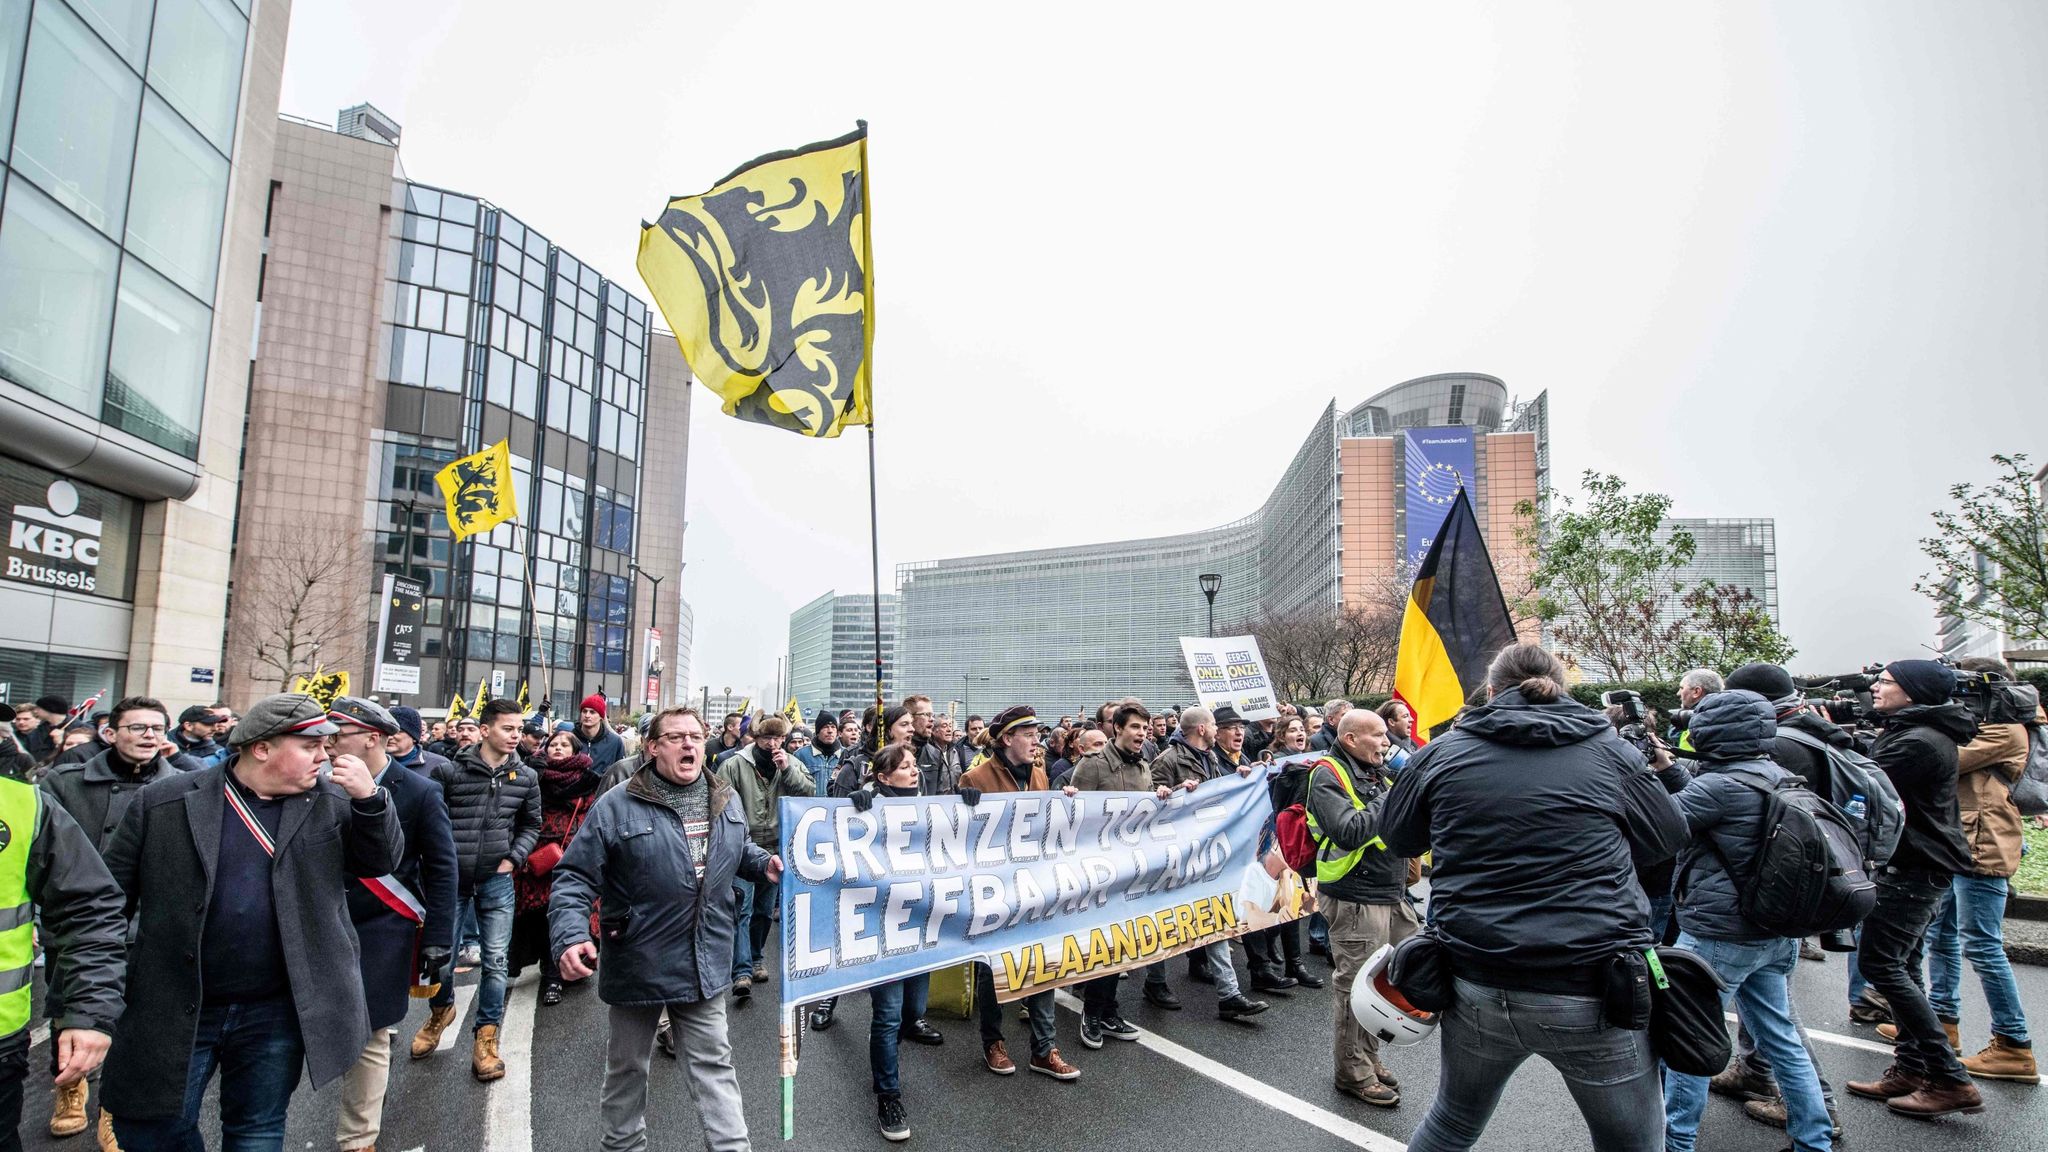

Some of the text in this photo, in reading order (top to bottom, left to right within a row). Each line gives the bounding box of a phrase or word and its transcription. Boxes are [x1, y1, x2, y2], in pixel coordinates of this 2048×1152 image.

[9, 520, 100, 566] KBC
[6, 556, 96, 591] Brussels
[395, 624, 413, 635] CATS
[1195, 654, 1215, 664] EERST
[1227, 652, 1251, 663] EERST
[1196, 666, 1224, 679] ONZE
[1228, 664, 1259, 678] ONZE
[1200, 681, 1230, 692] MENSEN
[1230, 678, 1266, 691] MENSEN
[1248, 696, 1268, 704] VLAAMS
[789, 798, 1084, 885] GRENZEN
[1099, 796, 1184, 850] TOE
[789, 832, 1232, 981] LEEFBAAR LAND
[1002, 893, 1239, 992] VLAANDEREN
